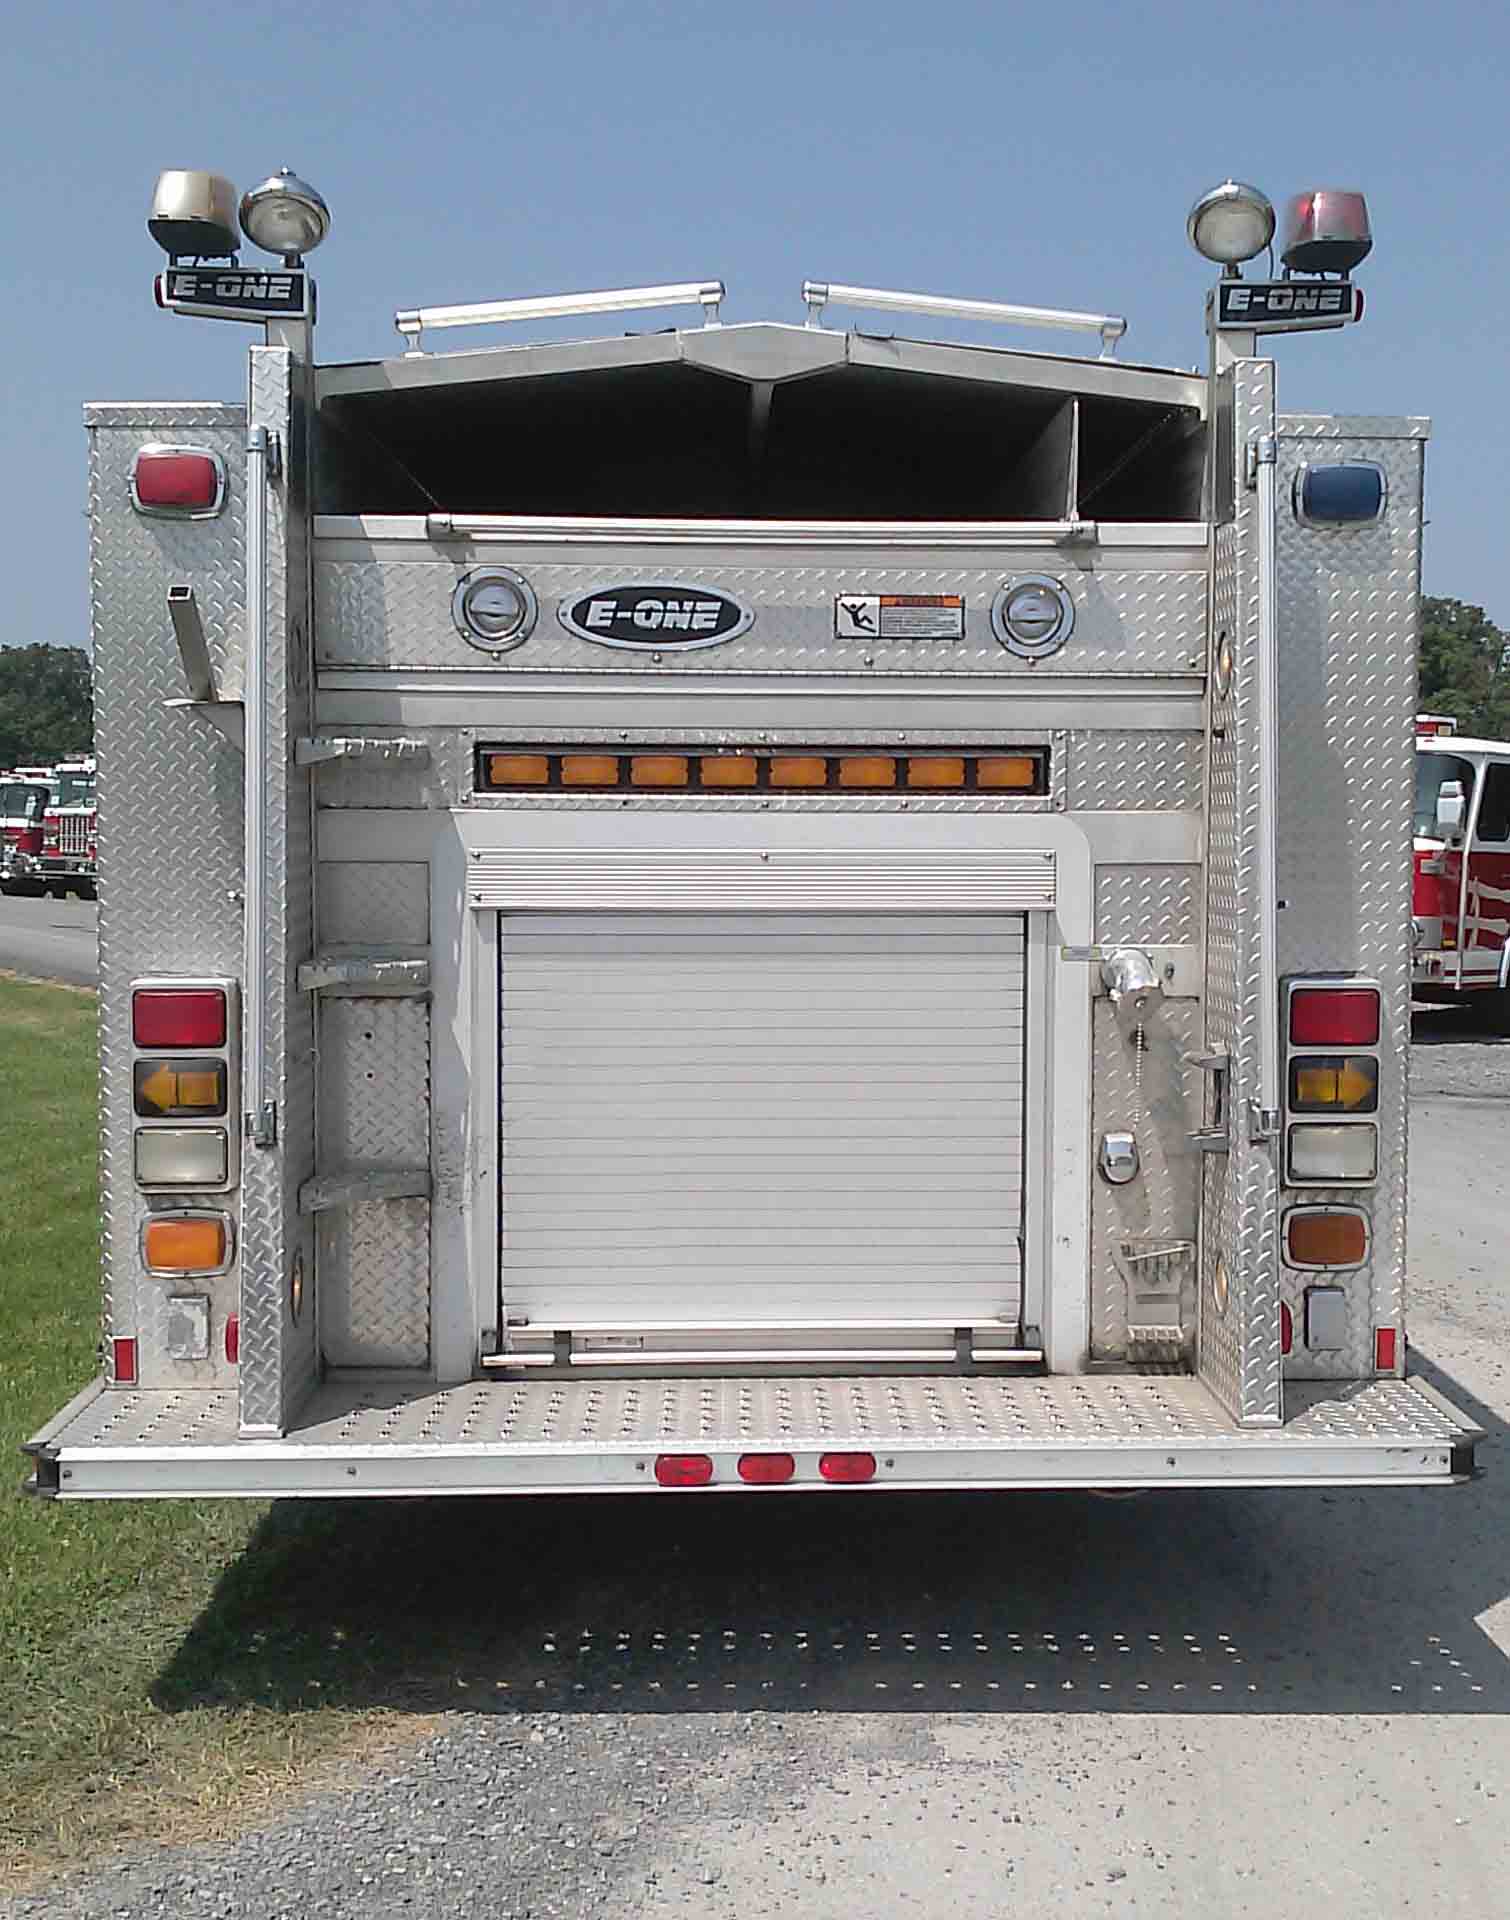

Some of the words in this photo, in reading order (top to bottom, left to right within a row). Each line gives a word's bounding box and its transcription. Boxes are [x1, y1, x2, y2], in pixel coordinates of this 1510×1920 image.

[174, 274, 293, 299] E-ONE
[1226, 288, 1343, 311] E-ONE
[585, 600, 722, 630] E-ONE
